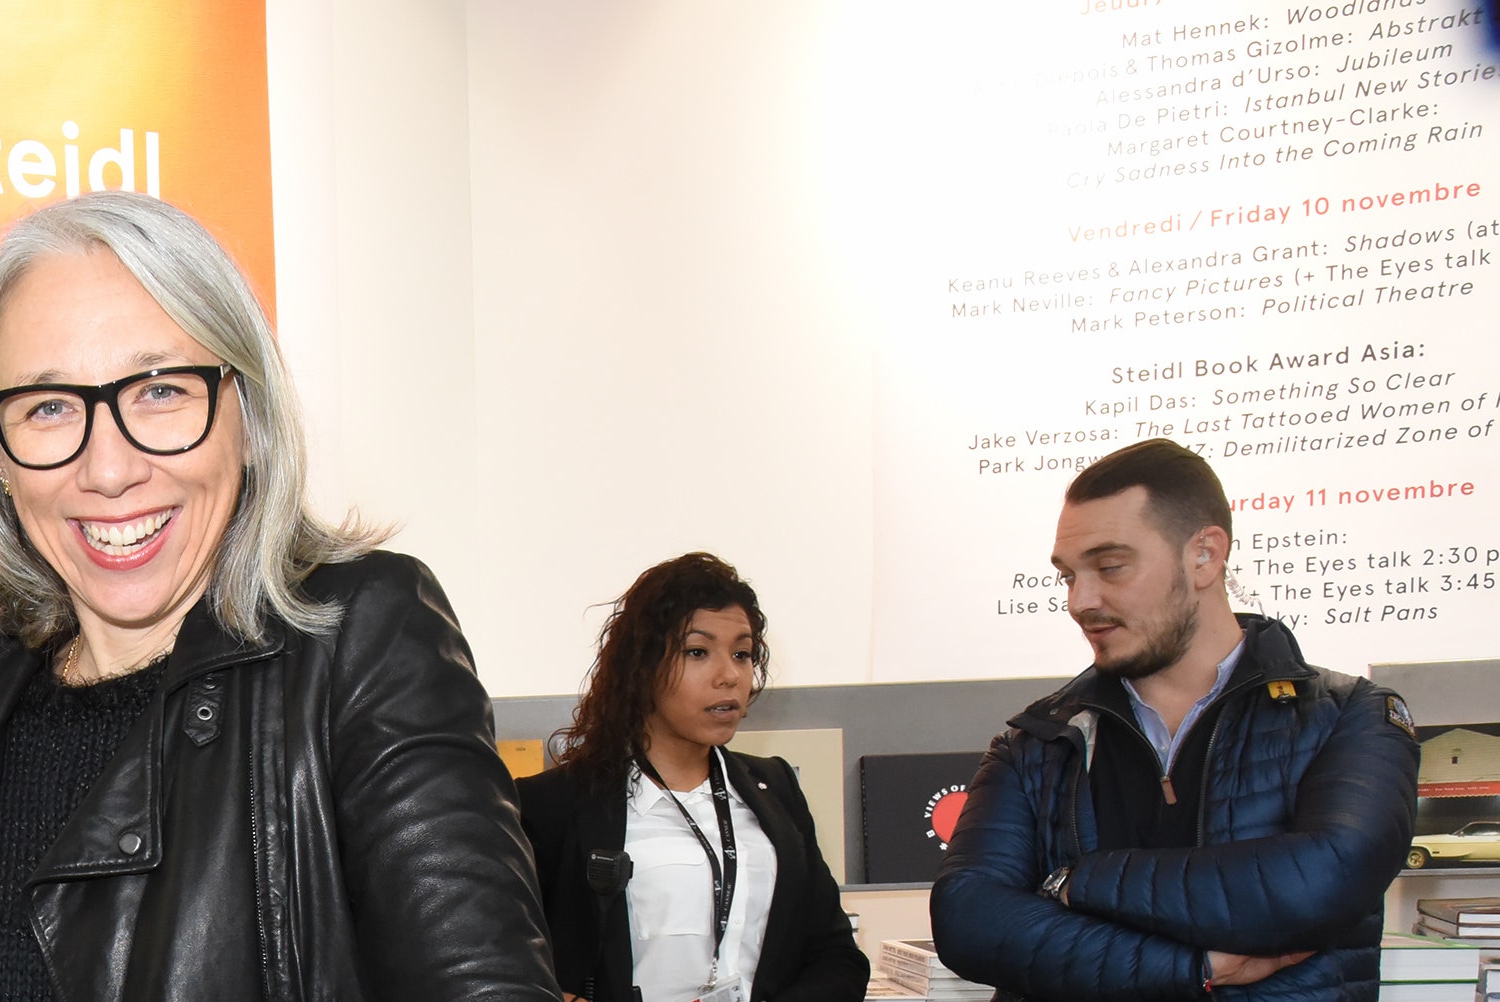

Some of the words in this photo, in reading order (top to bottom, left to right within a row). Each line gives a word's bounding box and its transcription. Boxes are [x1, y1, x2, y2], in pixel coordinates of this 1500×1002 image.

[1121, 30, 1162, 49] Mat
[1172, 14, 1270, 42] Hennek:
[1124, 58, 1139, 76] &
[1146, 46, 1236, 73] Thomas
[1246, 30, 1354, 58] Gizolme:
[1368, 7, 1485, 42] Abstrakt
[1094, 76, 1222, 106] Alessandra
[1336, 42, 1453, 74] Jubileum
[1117, 113, 1147, 131] De
[1156, 100, 1229, 125] Pietri:
[1244, 83, 1346, 114] Istanbul
[1354, 78, 1409, 100] New
[1417, 62, 1500, 90] Storie
[1066, 170, 1107, 191] Cry
[1114, 159, 1211, 184] Sadness
[1219, 151, 1266, 171] Into
[1275, 146, 1314, 165] the
[1323, 130, 1418, 159] Coming
[1427, 120, 1484, 145] Rain
[1107, 130, 1211, 158] Margaret
[1219, 102, 1439, 144] Courtney-Clarke:
[1067, 213, 1182, 243] Vendredi
[1209, 203, 1292, 228] Friday
[1301, 196, 1331, 217] 10
[1341, 182, 1482, 213] novembre
[948, 275, 1014, 294] Keanu
[1023, 266, 1101, 287] Reeves
[1107, 261, 1121, 278] &
[1128, 250, 1243, 276] Alexandra
[1252, 240, 1329, 264] Grant:
[1344, 228, 1457, 253] Shadows
[951, 300, 1002, 319] Mark
[1012, 291, 1093, 314] Neville:
[1109, 284, 1177, 305] Fancy
[1185, 272, 1284, 297] Pictures
[1325, 263, 1369, 283] The
[1380, 256, 1435, 279] Eyes
[1444, 248, 1492, 270] talk
[1071, 313, 1124, 334] Mark
[1134, 305, 1246, 329] Peterson:
[1262, 289, 1365, 316] Political
[1375, 280, 1475, 305] Theatre
[1111, 361, 1183, 385] Steidl
[1194, 354, 1259, 378] Book
[1269, 345, 1350, 371] Award
[1360, 340, 1426, 363] Asia:
[968, 432, 1017, 451] Jake
[1025, 427, 1119, 446] Verzosa:
[1134, 419, 1174, 439] The
[1183, 414, 1232, 435] Last
[1240, 404, 1351, 430] Tattooed
[1361, 397, 1451, 421] Women
[1460, 391, 1488, 411] of
[1084, 395, 1139, 418] Kapil
[1149, 393, 1197, 412] Das:
[1212, 380, 1340, 406] Something
[1347, 376, 1376, 395] So
[1385, 369, 1457, 391] Clear
[978, 456, 1026, 476] Park
[1223, 428, 1387, 458] Demilitarized
[1395, 426, 1458, 446] Zone
[1467, 418, 1495, 439] of
[1305, 488, 1327, 507] 11
[1338, 480, 1475, 505] novembre
[1012, 571, 1065, 589] Rock
[1253, 557, 1295, 576] The
[1305, 554, 1357, 577] Eyes
[1367, 550, 1412, 570] talk
[1422, 546, 1478, 566] 2:30
[1252, 529, 1348, 553] Epstein:
[997, 598, 1039, 615] Lise
[1270, 583, 1312, 602] The
[1323, 580, 1375, 602] Eyes
[1384, 576, 1430, 596] talk
[1440, 571, 1496, 592] 3:45
[1324, 606, 1373, 625] Salt
[1380, 603, 1439, 623] Pans
[924, 788, 948, 818] VIEWS
[950, 784, 966, 792] OF
